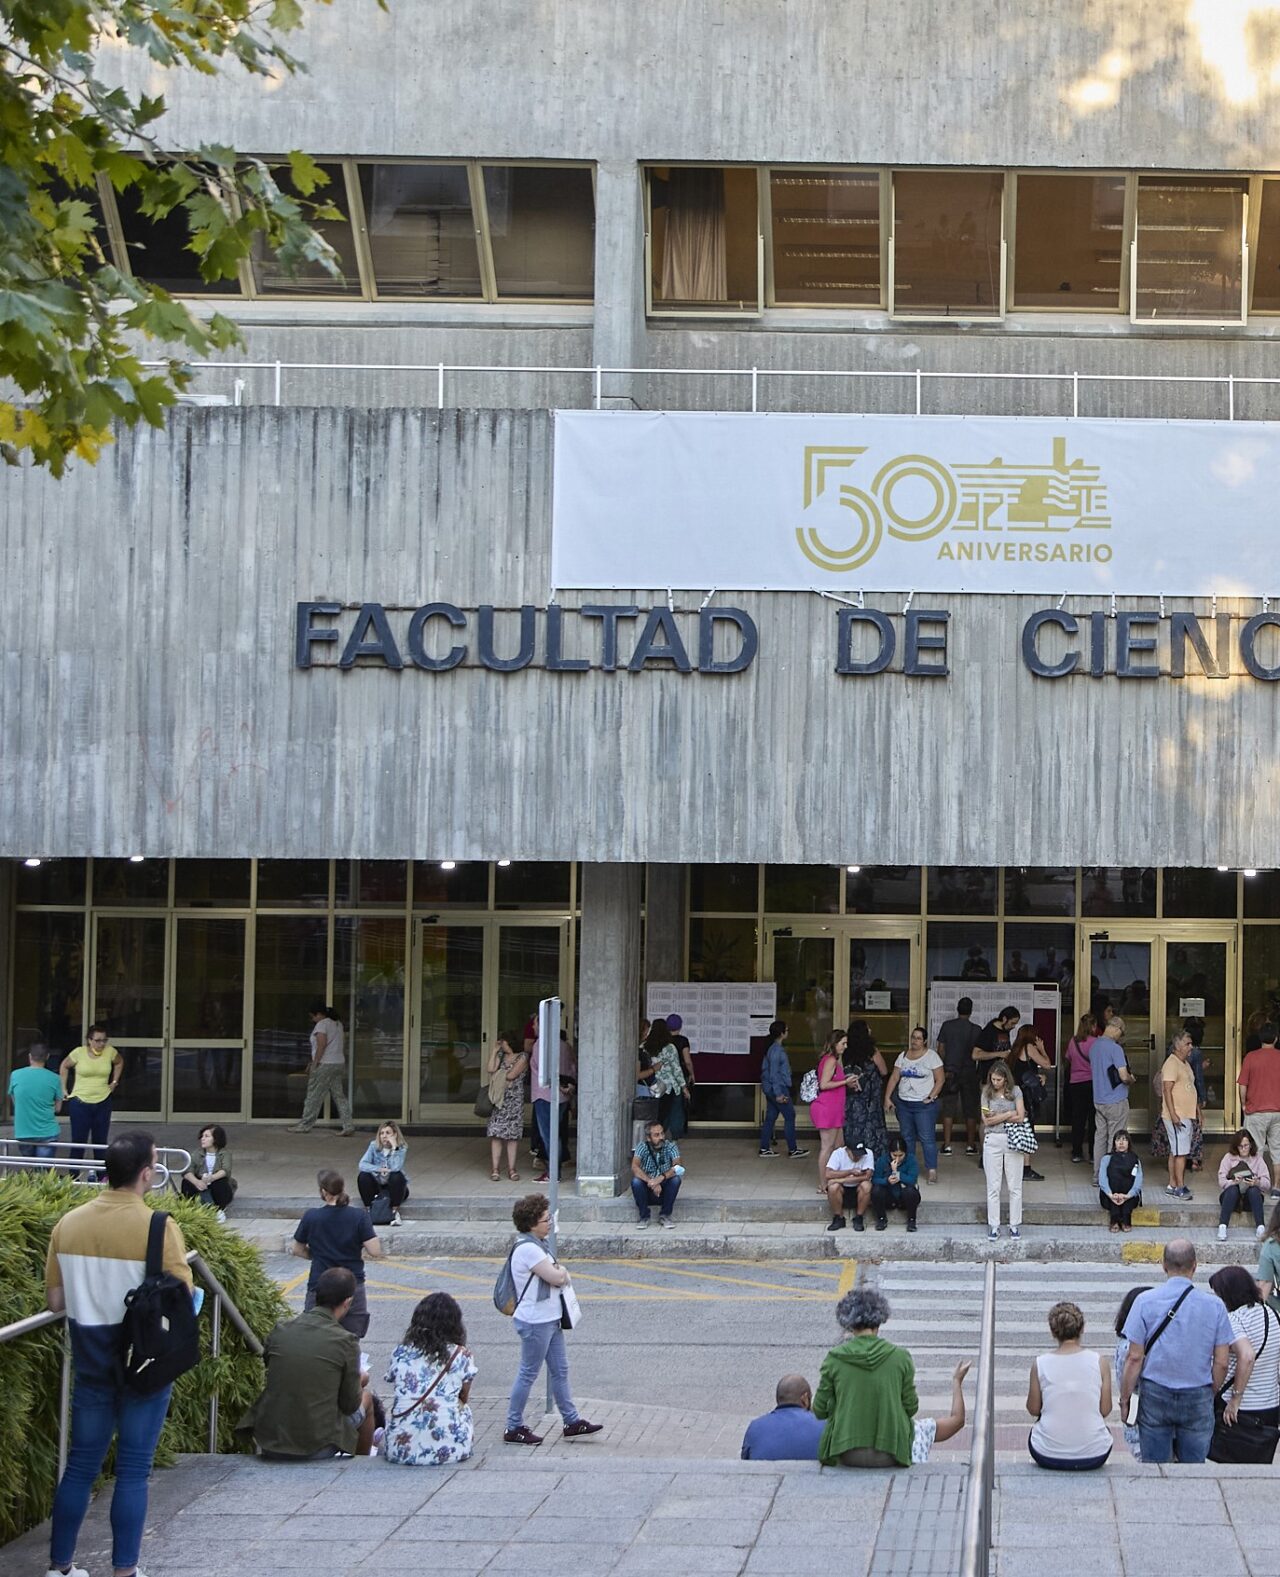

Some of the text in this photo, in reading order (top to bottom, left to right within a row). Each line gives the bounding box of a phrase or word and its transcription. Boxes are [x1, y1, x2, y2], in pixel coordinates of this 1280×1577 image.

[936, 541, 1113, 563] ANIVERSARIO
[298, 601, 760, 673] FACULTAD
[836, 607, 951, 675] DE
